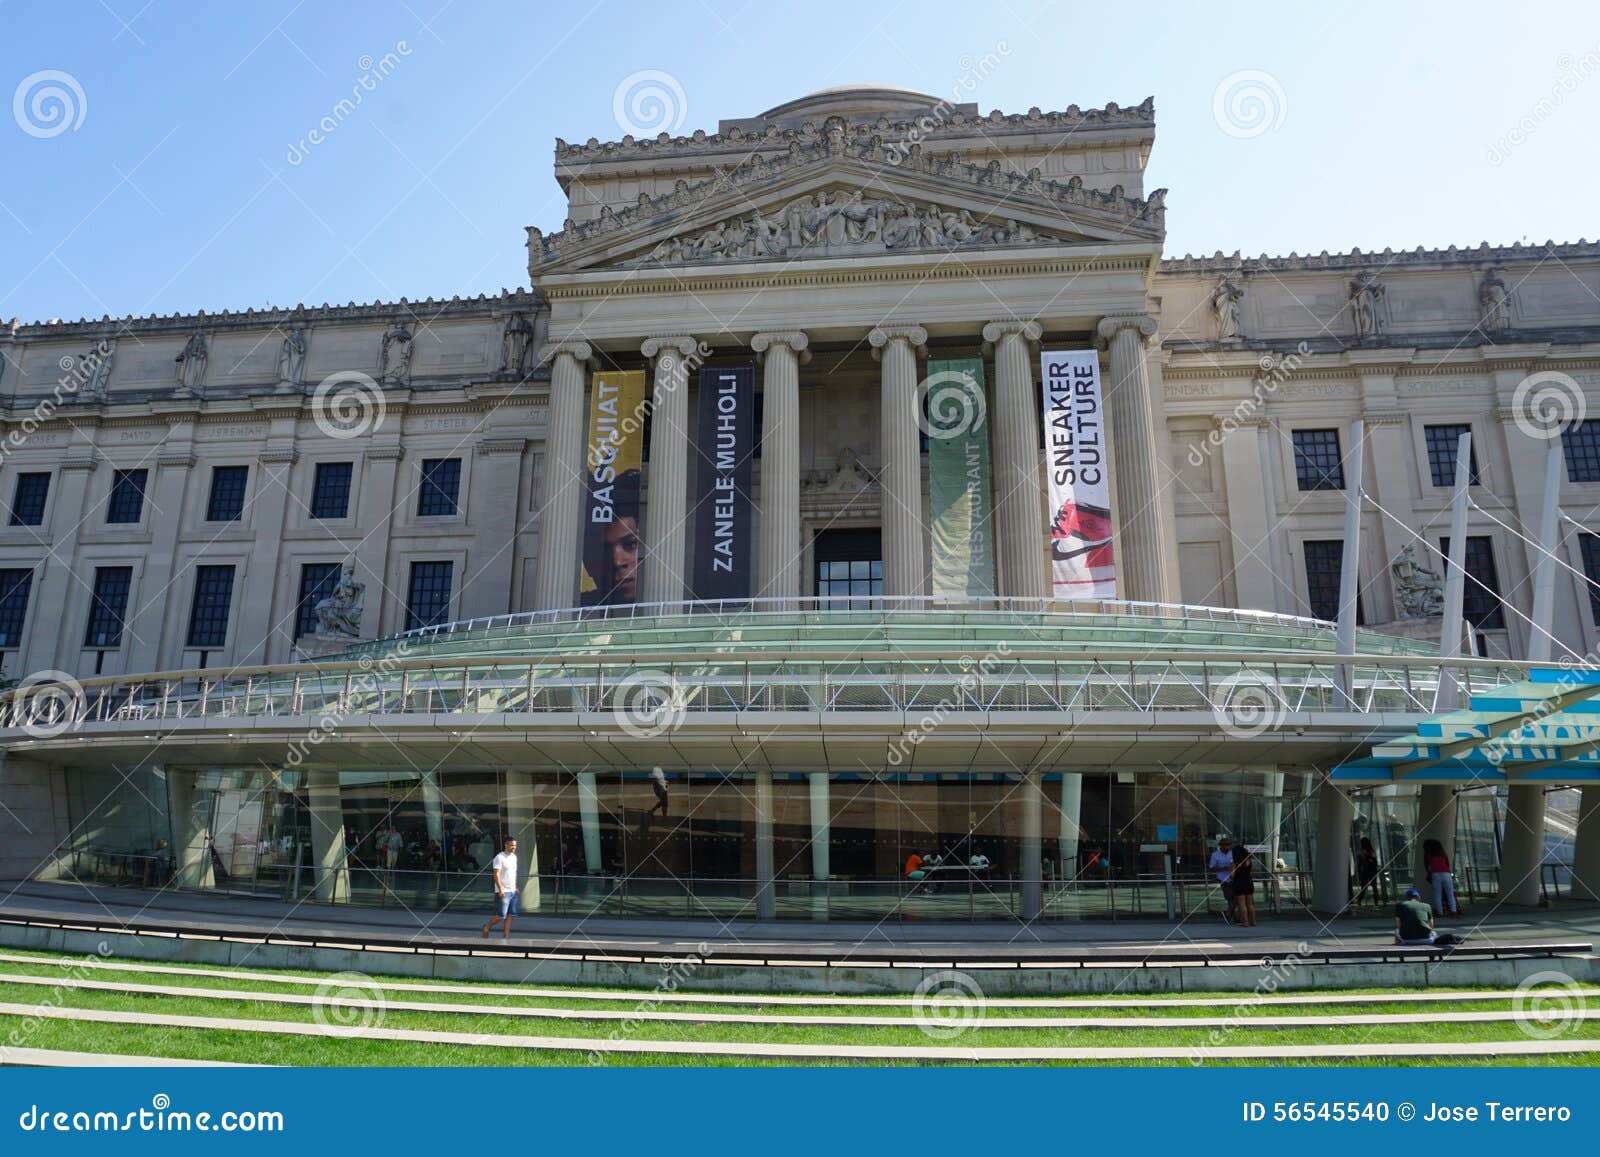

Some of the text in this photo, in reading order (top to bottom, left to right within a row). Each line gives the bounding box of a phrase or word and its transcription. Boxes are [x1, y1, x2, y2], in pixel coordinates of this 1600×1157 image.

[592, 380, 618, 523] BASQUIAT
[713, 374, 737, 572] ZANELE MUHOLI
[1050, 361, 1076, 486] SNEAKER
[1074, 364, 1101, 486] CULTURE
[965, 442, 985, 567] RESTAURANT
